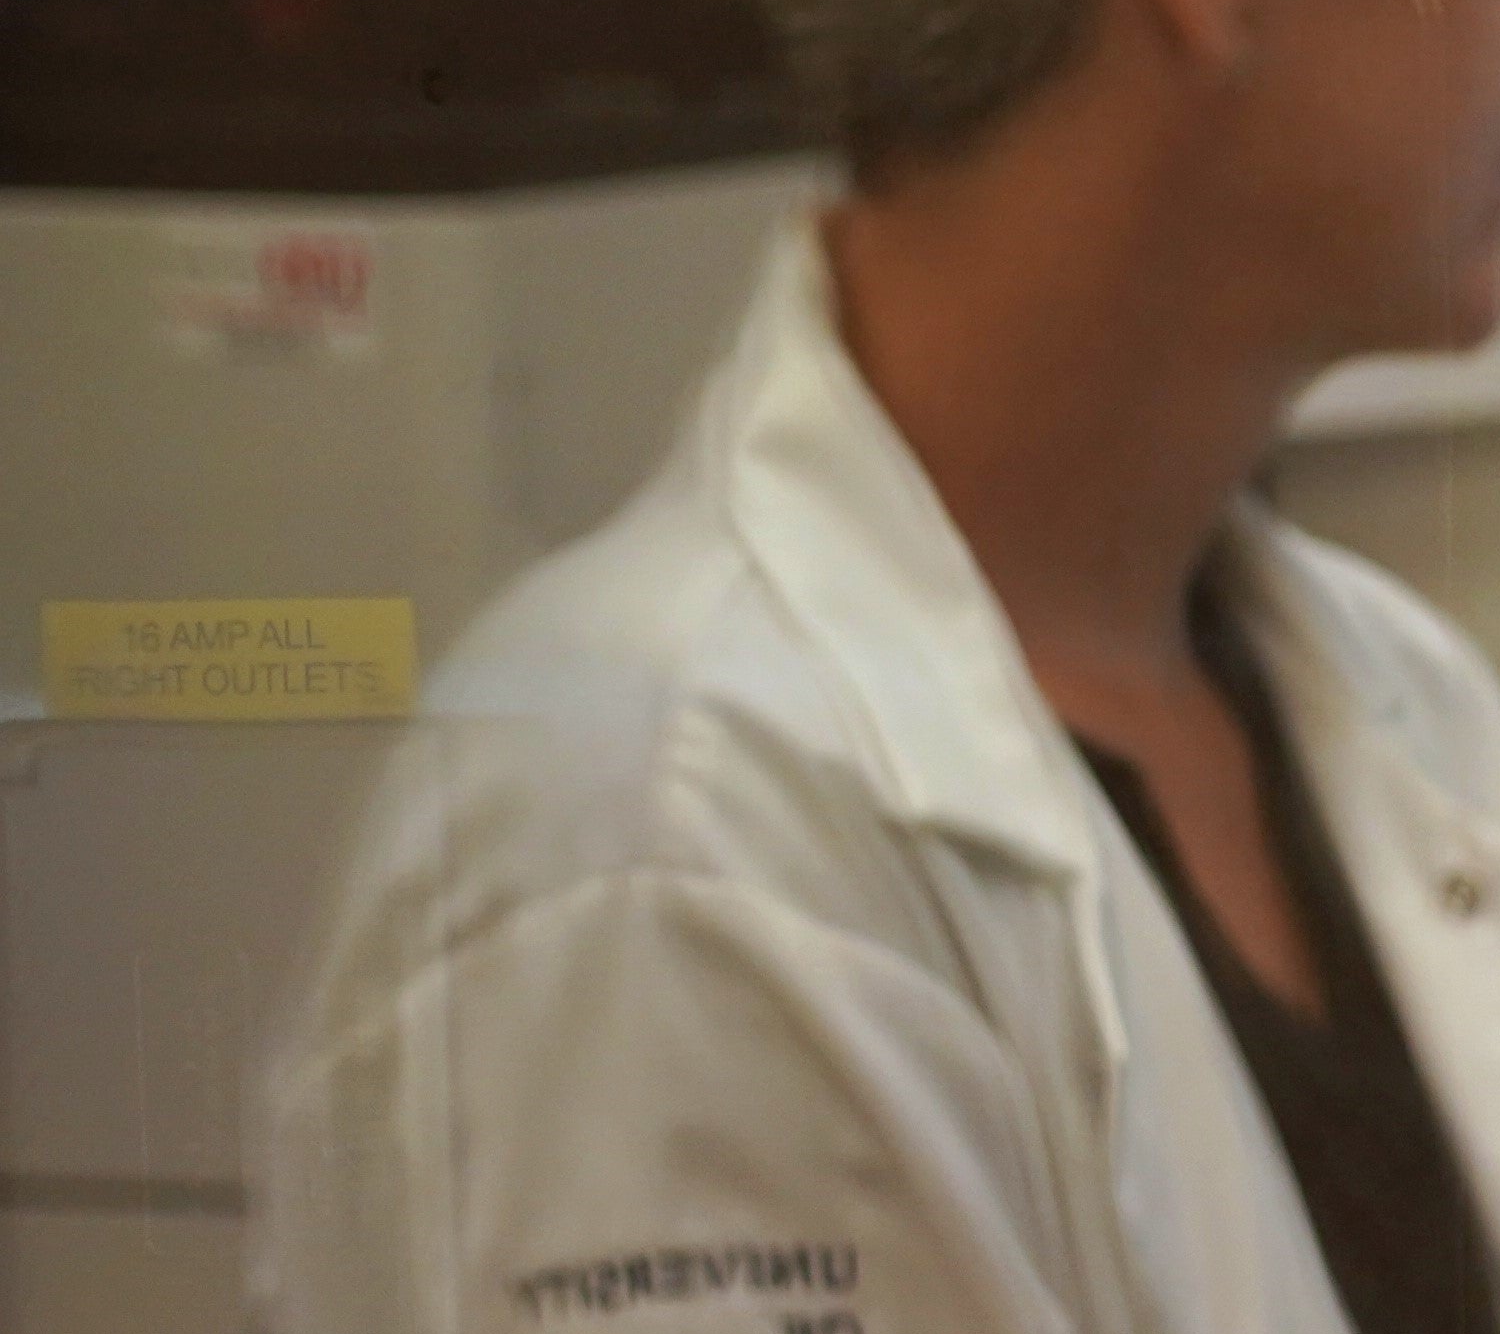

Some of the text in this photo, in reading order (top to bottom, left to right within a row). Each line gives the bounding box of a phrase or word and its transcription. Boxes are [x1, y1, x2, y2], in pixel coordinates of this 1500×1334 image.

[120, 619, 328, 654] 16 AMP ALL
[200, 661, 384, 696] OUTLETS
